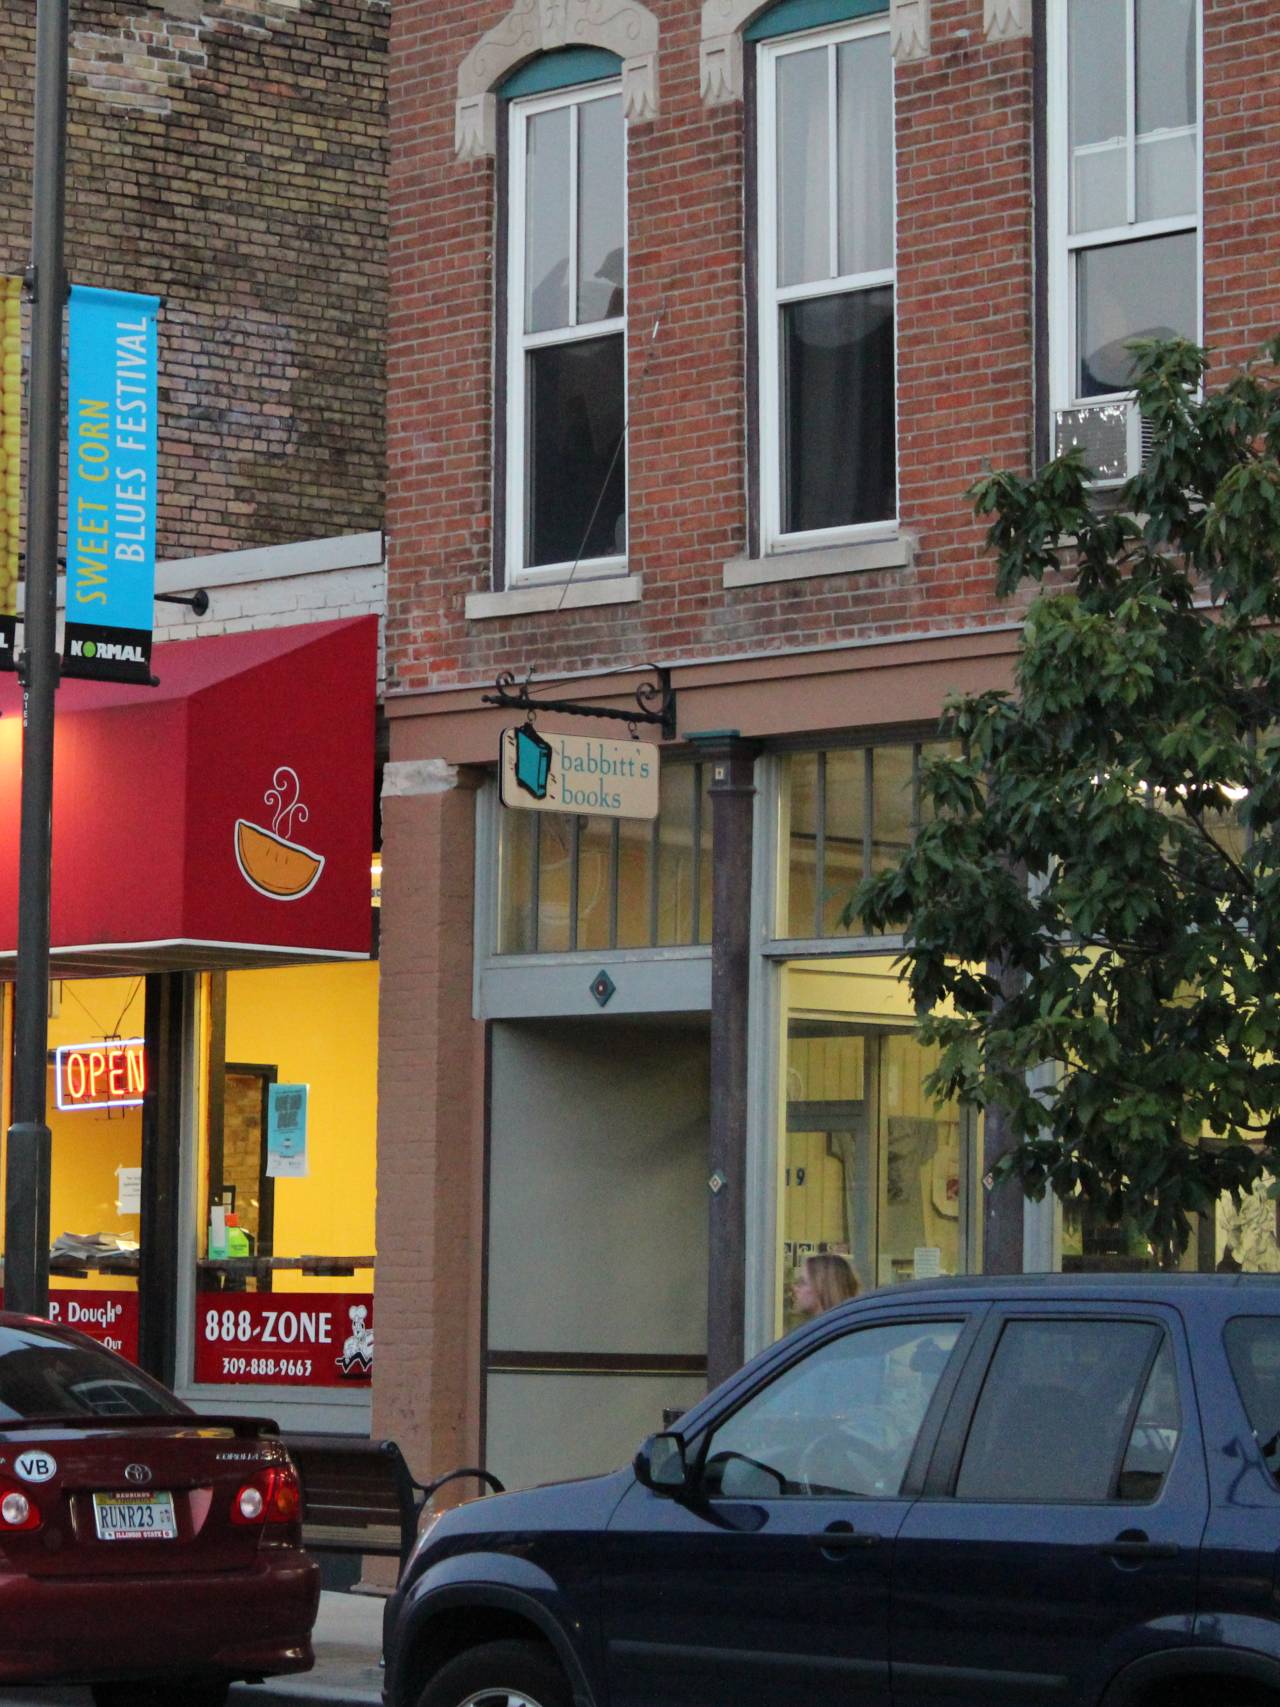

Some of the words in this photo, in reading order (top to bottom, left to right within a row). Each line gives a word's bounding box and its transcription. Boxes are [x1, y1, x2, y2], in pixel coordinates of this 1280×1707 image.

[116, 316, 147, 450] FESTIVAL
[78, 399, 109, 482] CORN
[115, 469, 145, 562] BLUES
[77, 497, 109, 604] SWEET
[71, 640, 144, 662] NORMAL
[561, 741, 650, 779] babbitt's
[561, 774, 622, 809] books
[66, 1050, 144, 1098] OPEN
[49, 1302, 61, 1321] P.
[205, 1310, 332, 1343] 888-ZONE
[222, 1357, 312, 1376] 309-888-9663
[21, 1459, 49, 1475] VB
[100, 1506, 154, 1528] RUNR23
